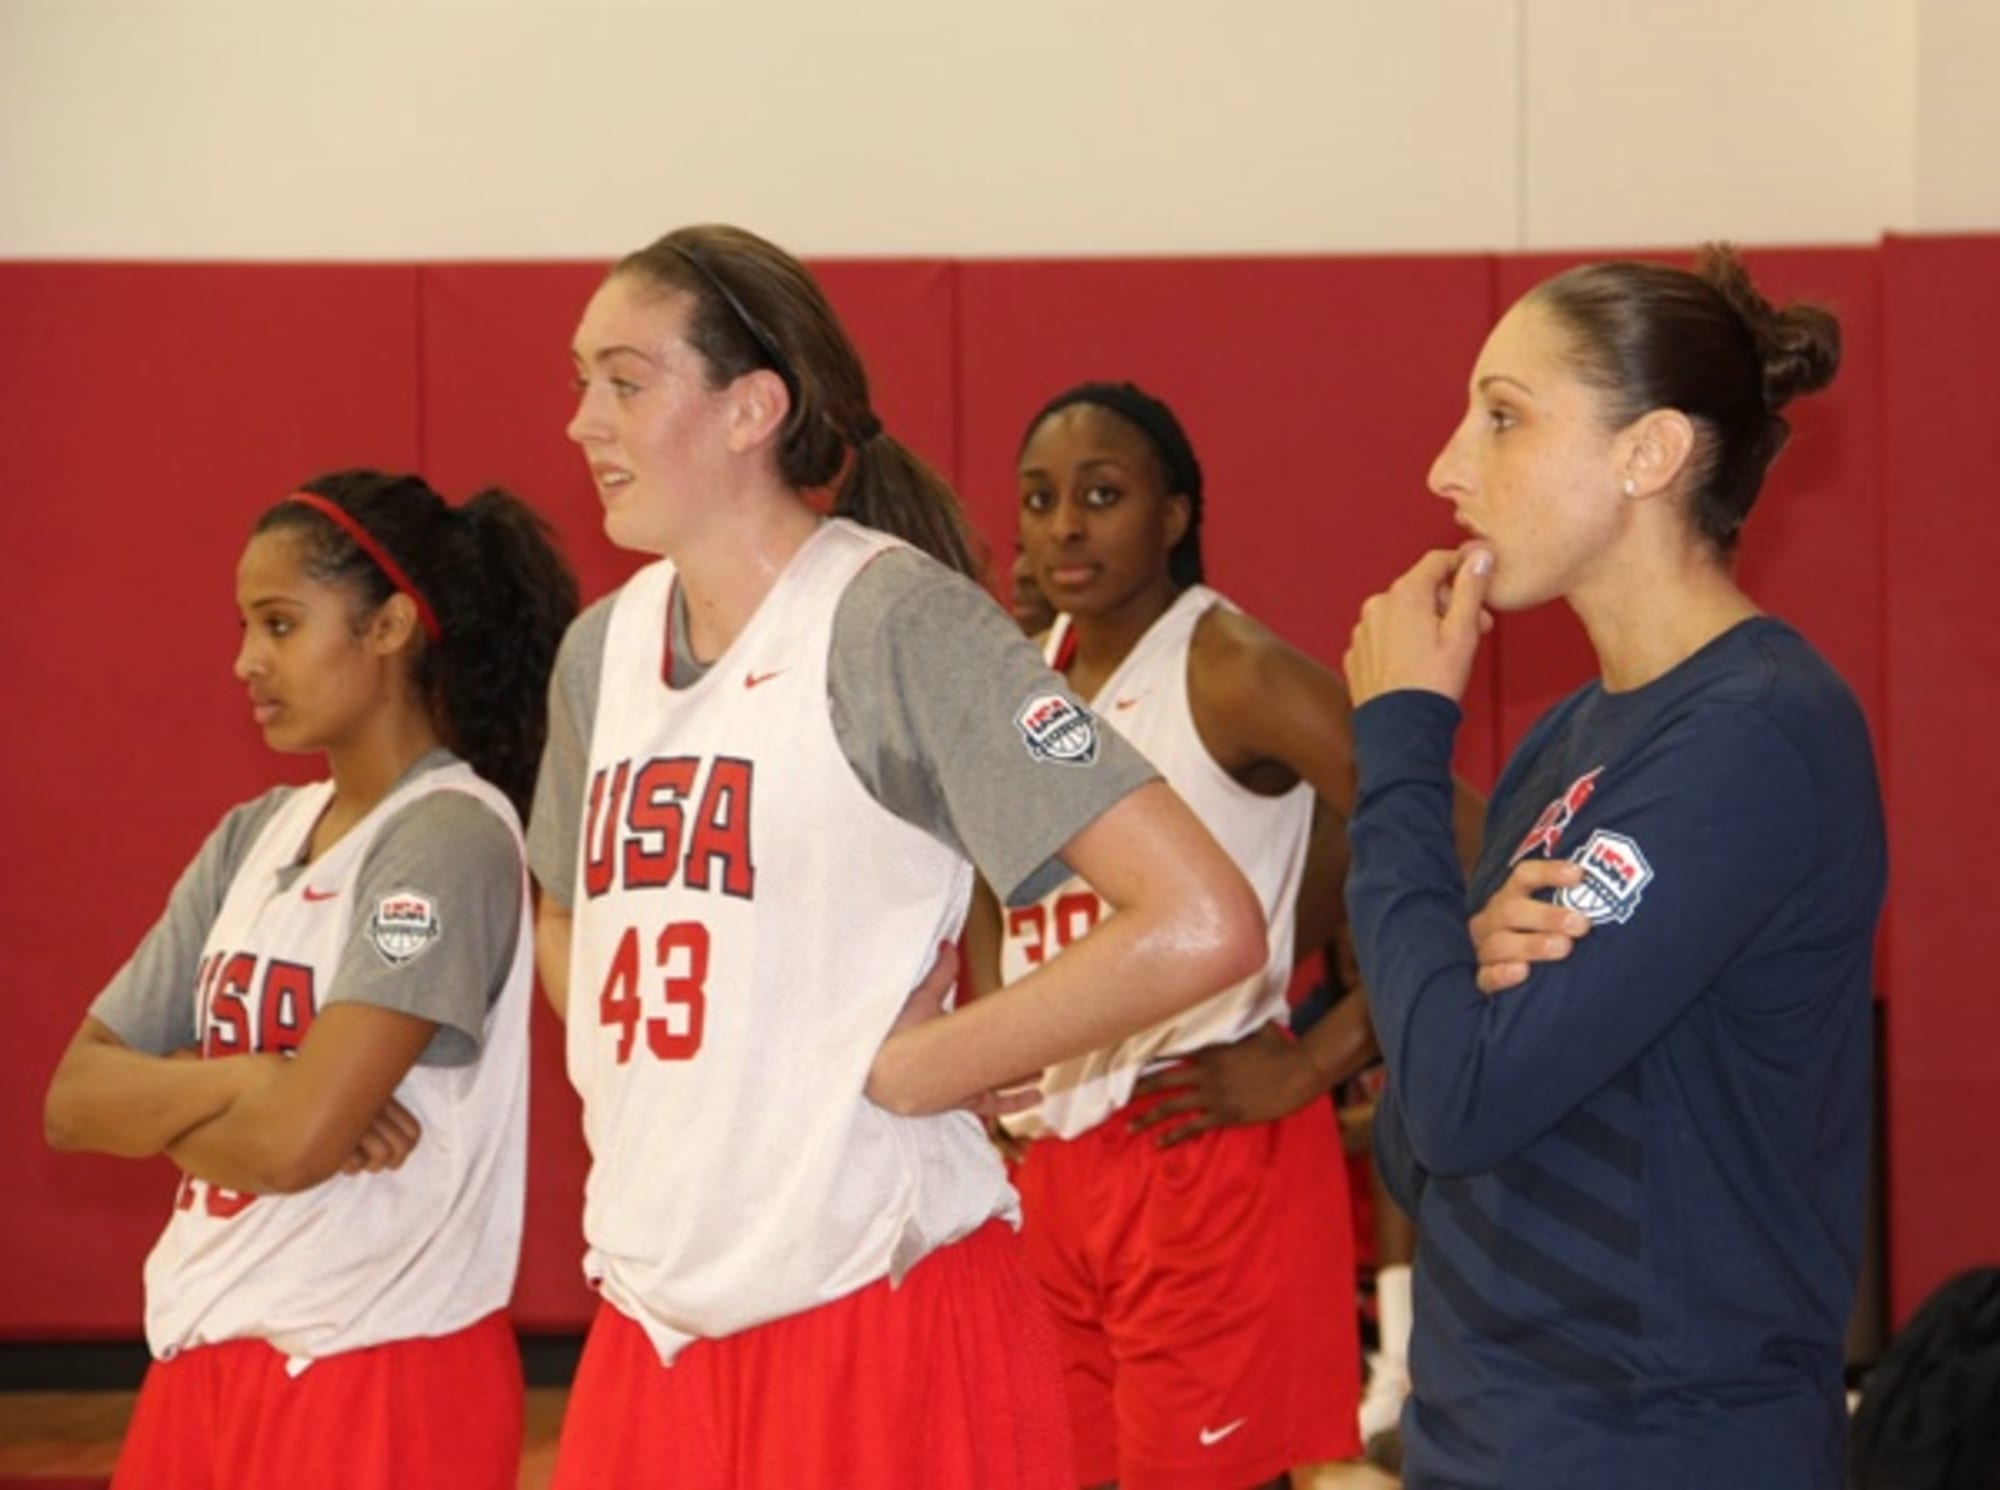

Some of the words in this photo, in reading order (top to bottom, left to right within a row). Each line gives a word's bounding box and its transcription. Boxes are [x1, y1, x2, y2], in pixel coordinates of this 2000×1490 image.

[585, 755, 755, 902] USA
[194, 950, 319, 1059] USA
[599, 920, 711, 1066] 43
